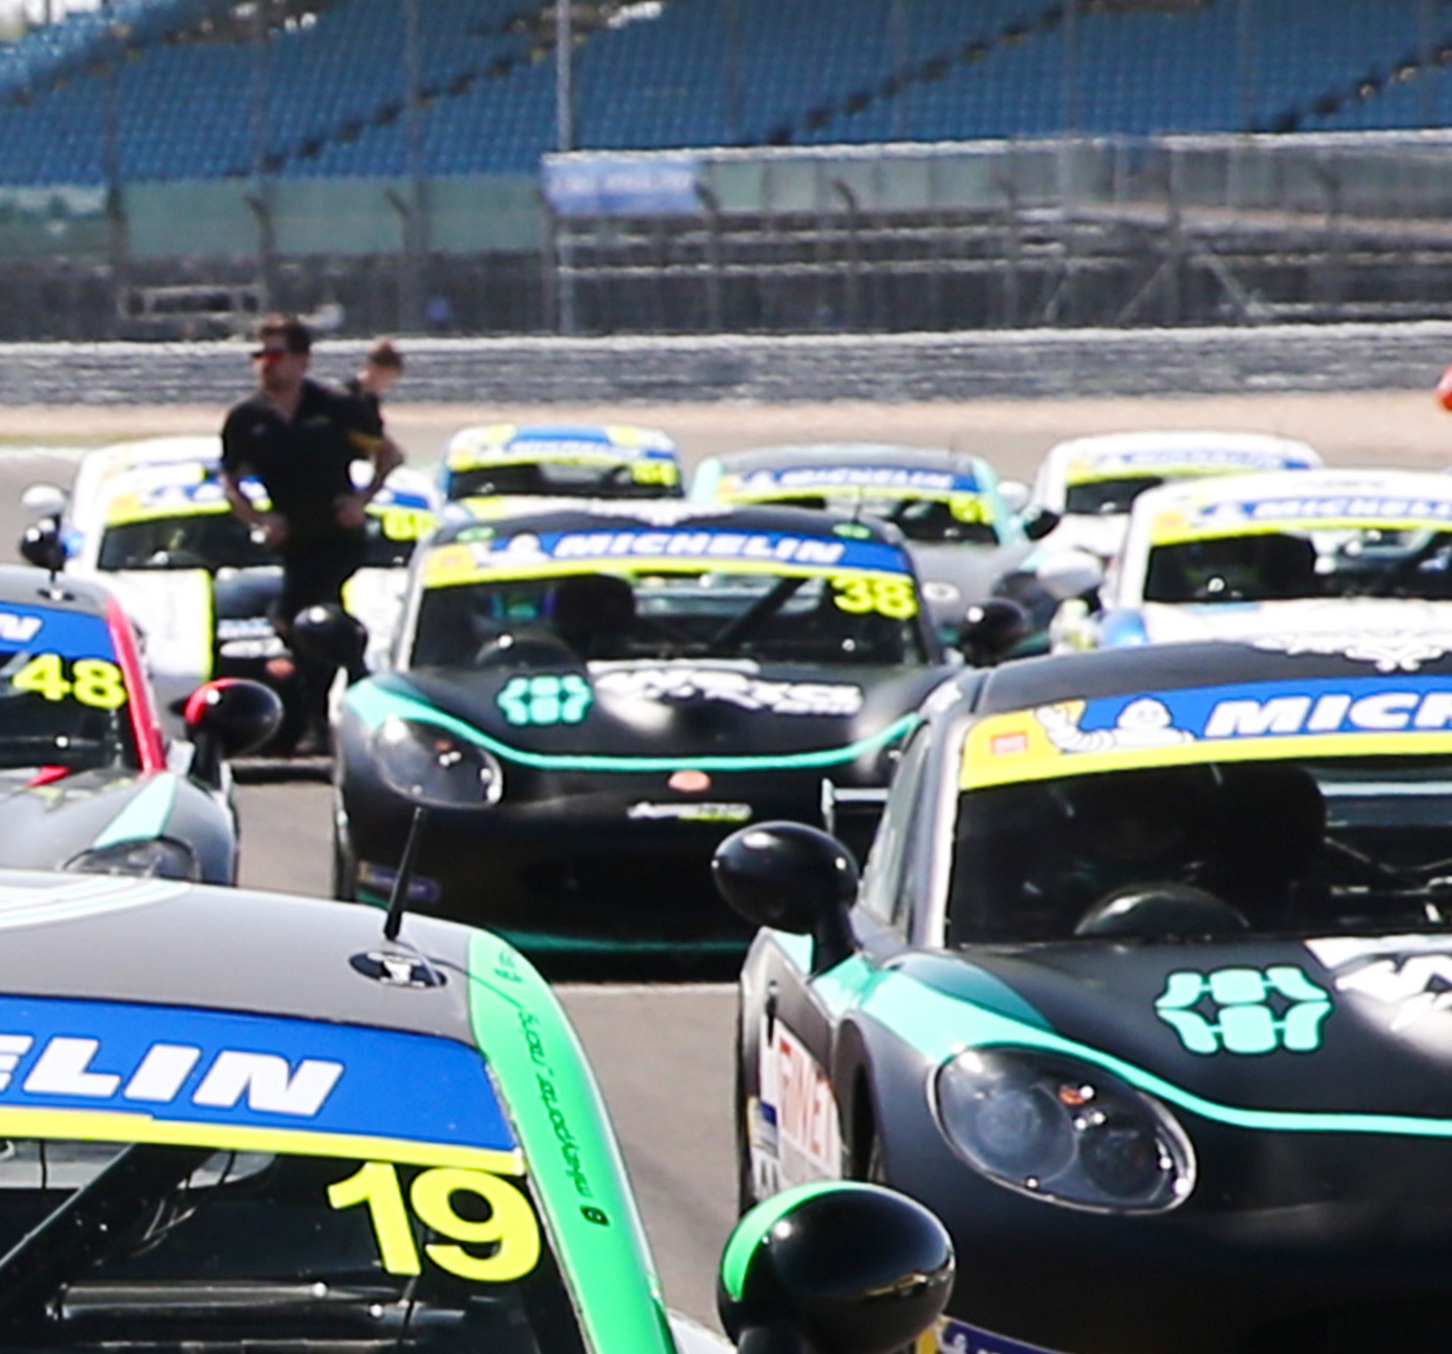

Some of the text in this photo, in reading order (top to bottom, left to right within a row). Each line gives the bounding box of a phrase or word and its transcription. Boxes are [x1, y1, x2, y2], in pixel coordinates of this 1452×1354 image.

[552, 533, 846, 564] MICHELIN
[832, 573, 920, 619] 38
[10, 655, 128, 711] 48
[327, 1161, 542, 1283] 19
